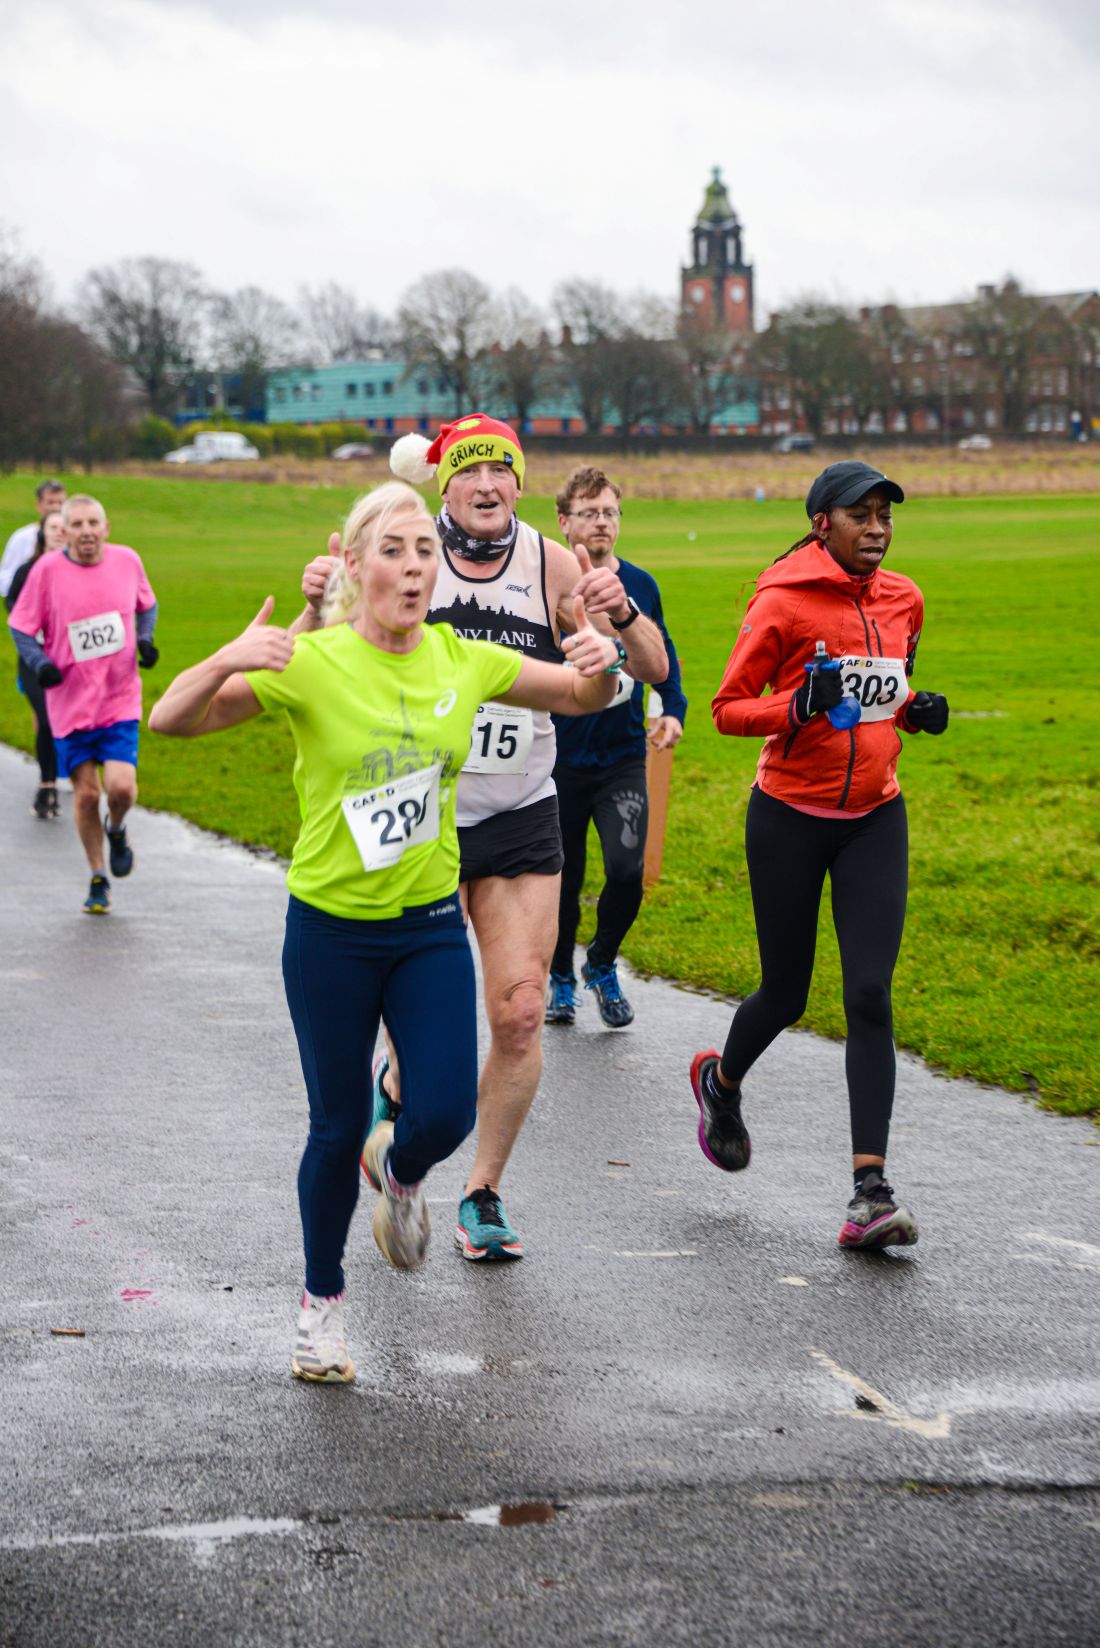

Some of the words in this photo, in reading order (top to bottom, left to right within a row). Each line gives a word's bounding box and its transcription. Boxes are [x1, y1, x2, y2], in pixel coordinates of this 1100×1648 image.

[450, 443, 494, 467] GRINCH
[78, 624, 118, 651] 262
[486, 629, 536, 648] LANE
[844, 673, 898, 708] 303
[477, 722, 519, 760] 15
